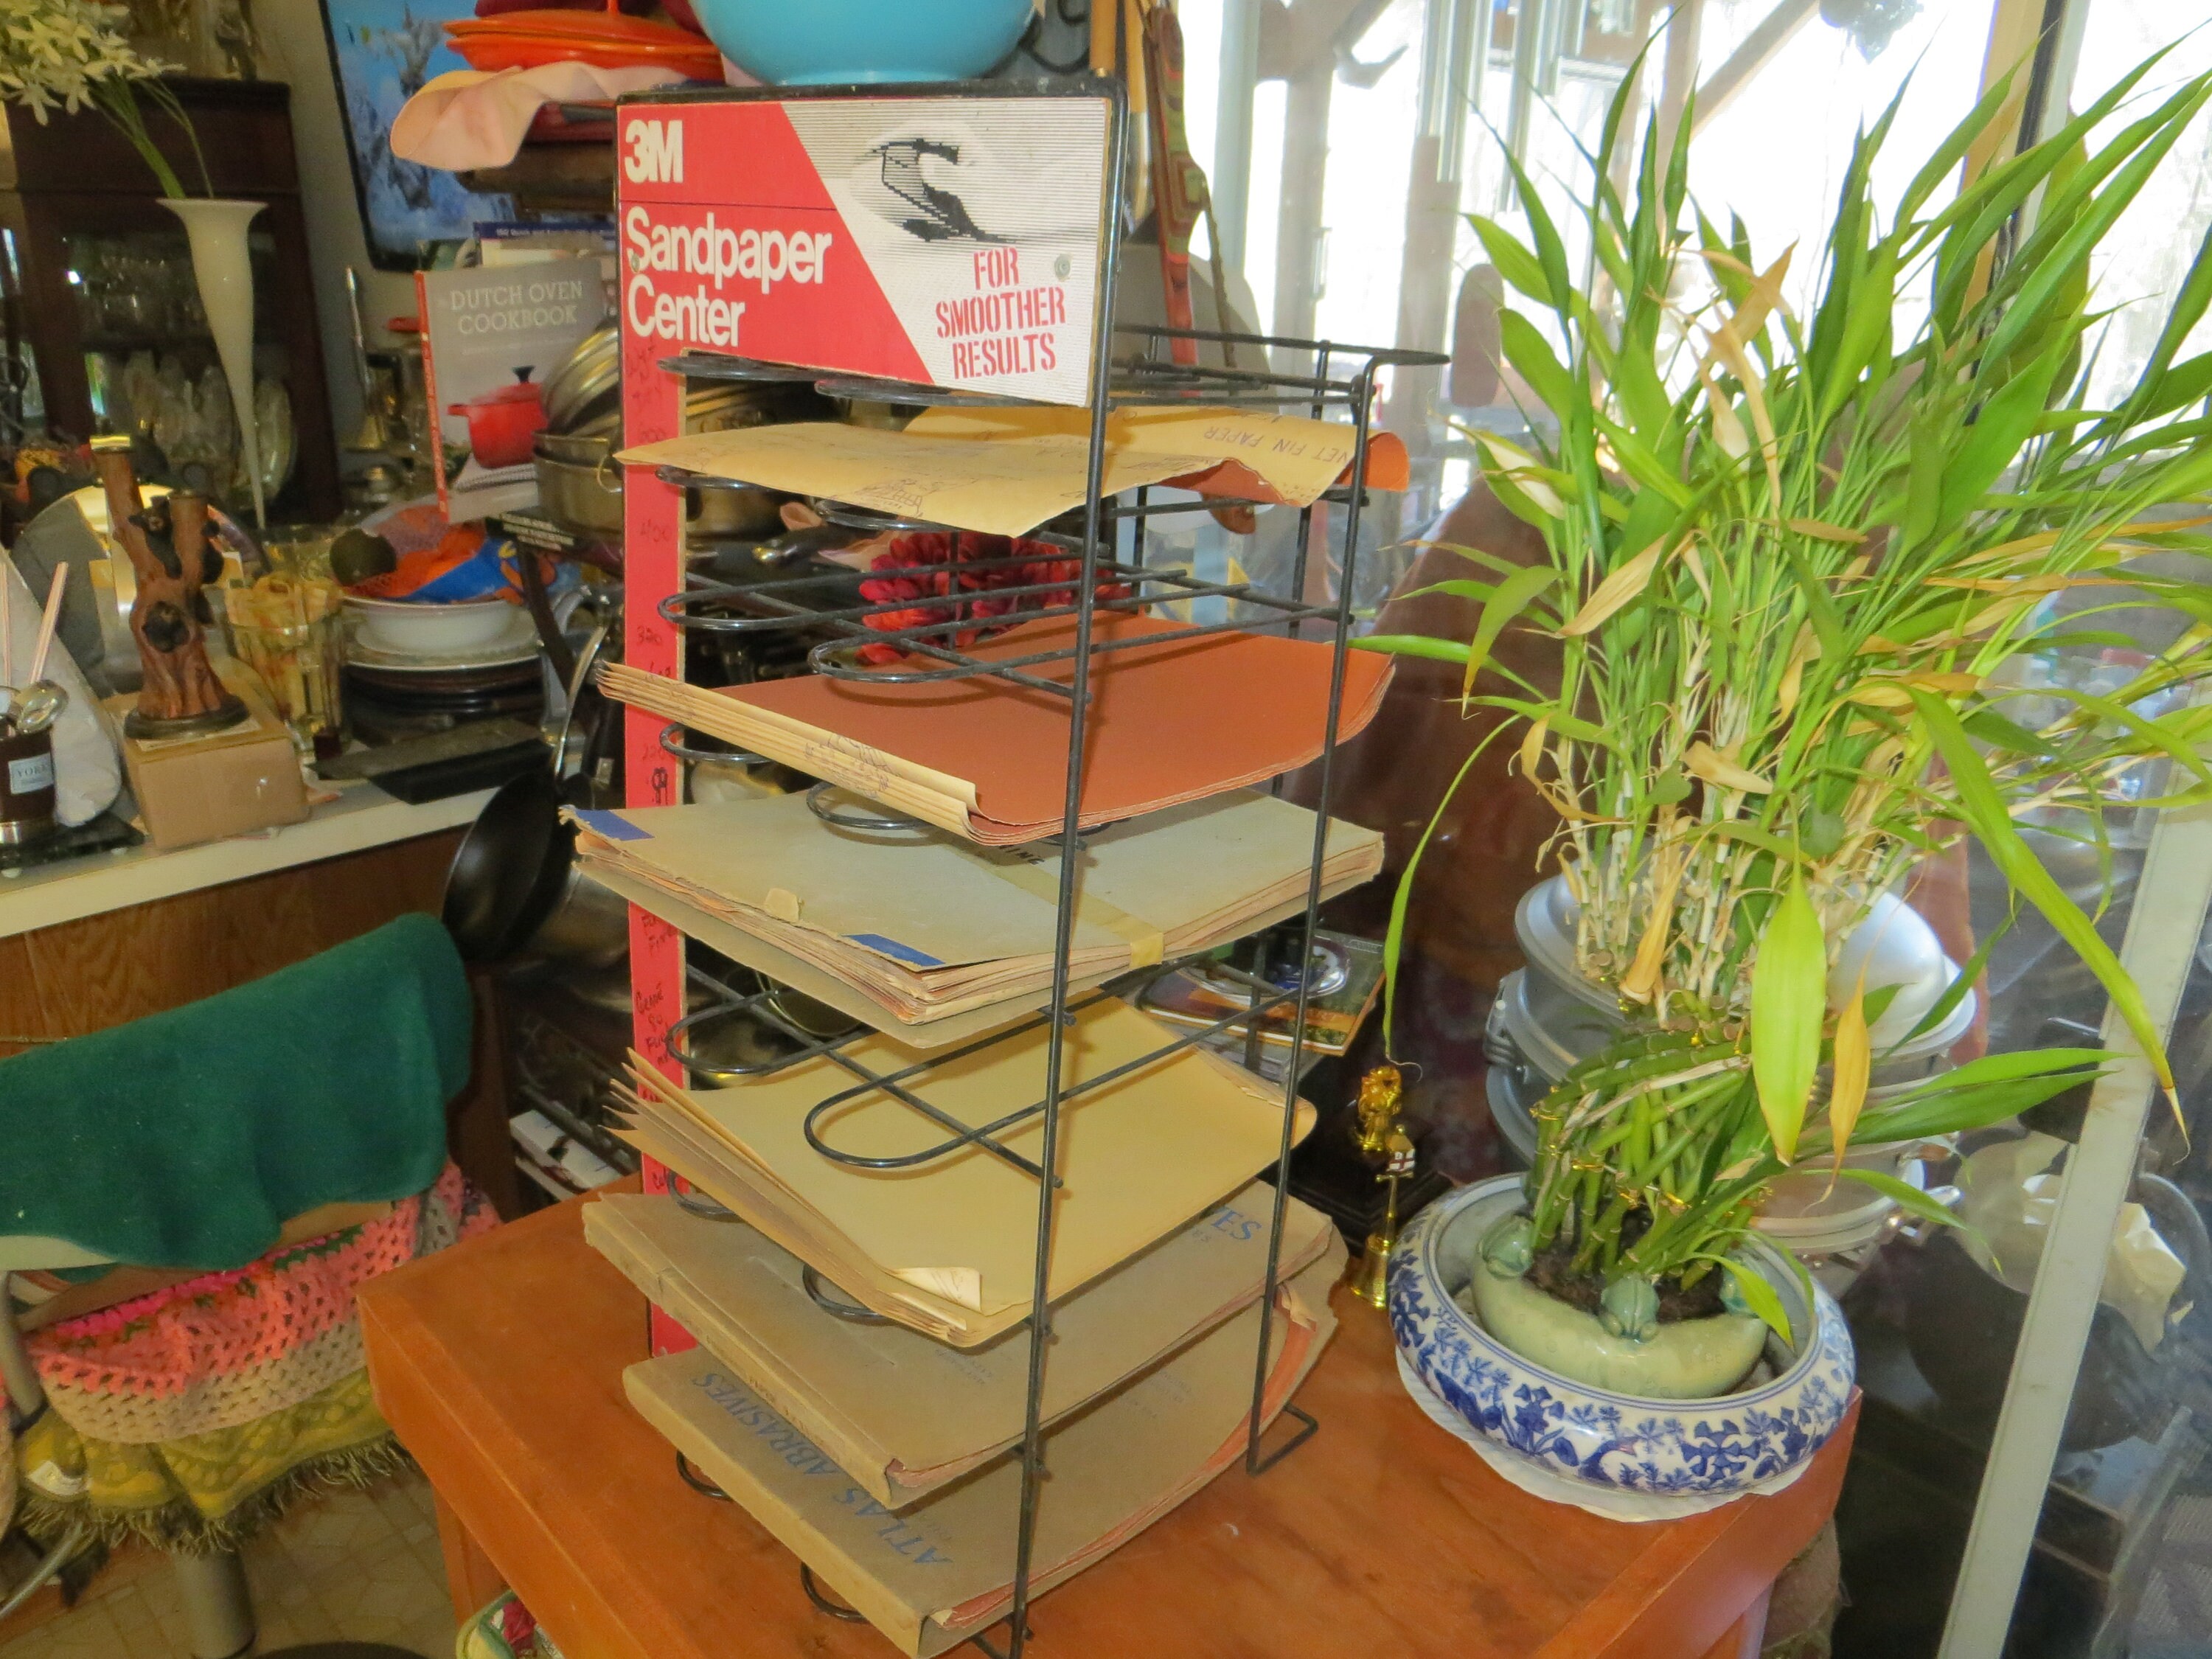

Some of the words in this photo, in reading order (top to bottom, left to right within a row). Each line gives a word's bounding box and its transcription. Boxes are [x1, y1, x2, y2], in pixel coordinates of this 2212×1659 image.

[625, 119, 684, 184] 3M
[626, 206, 832, 295] Sandpaper
[973, 247, 1019, 291] FOR
[451, 285, 523, 311] DUTCH
[529, 280, 582, 303] OVEN
[458, 305, 577, 335] COOKBOOK
[627, 274, 746, 348] Center
[936, 286, 1066, 339] SMOOTHER
[952, 333, 1057, 379] RESULTS
[1203, 425, 1265, 448] PAPER
[693, 1372, 841, 1476] ABRASIVES
[834, 1486, 953, 1565] ATLAS
